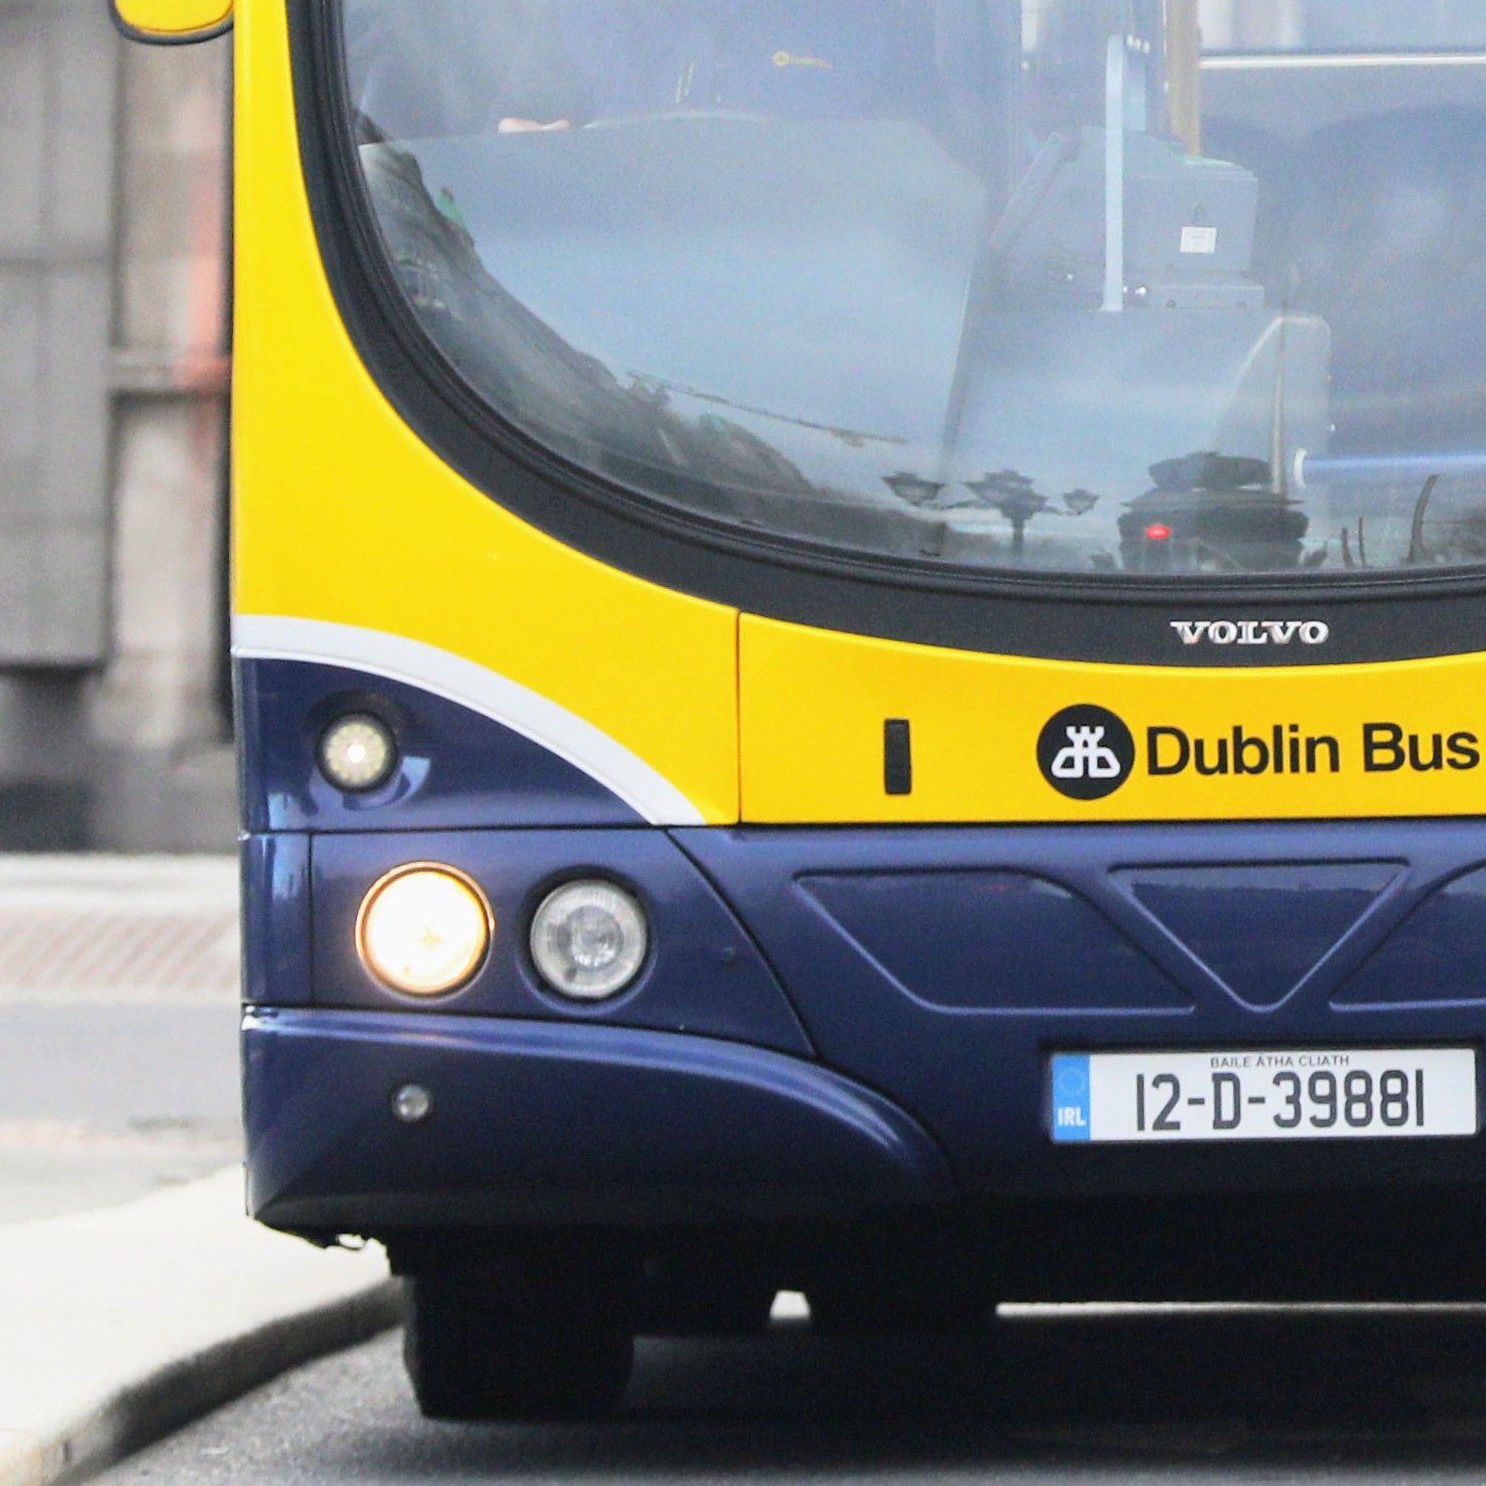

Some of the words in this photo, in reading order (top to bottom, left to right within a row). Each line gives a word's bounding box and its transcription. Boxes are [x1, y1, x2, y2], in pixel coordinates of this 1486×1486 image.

[1169, 619, 1329, 645] VOLVO
[1146, 722, 1340, 777] Dublin
[1362, 721, 1481, 773] Bus
[1210, 1057, 1252, 1068] BAILE
[1298, 1055, 1350, 1067] CLIATH
[1136, 1069, 1425, 1132] 12-D-39881
[1057, 1107, 1087, 1127] IRL
